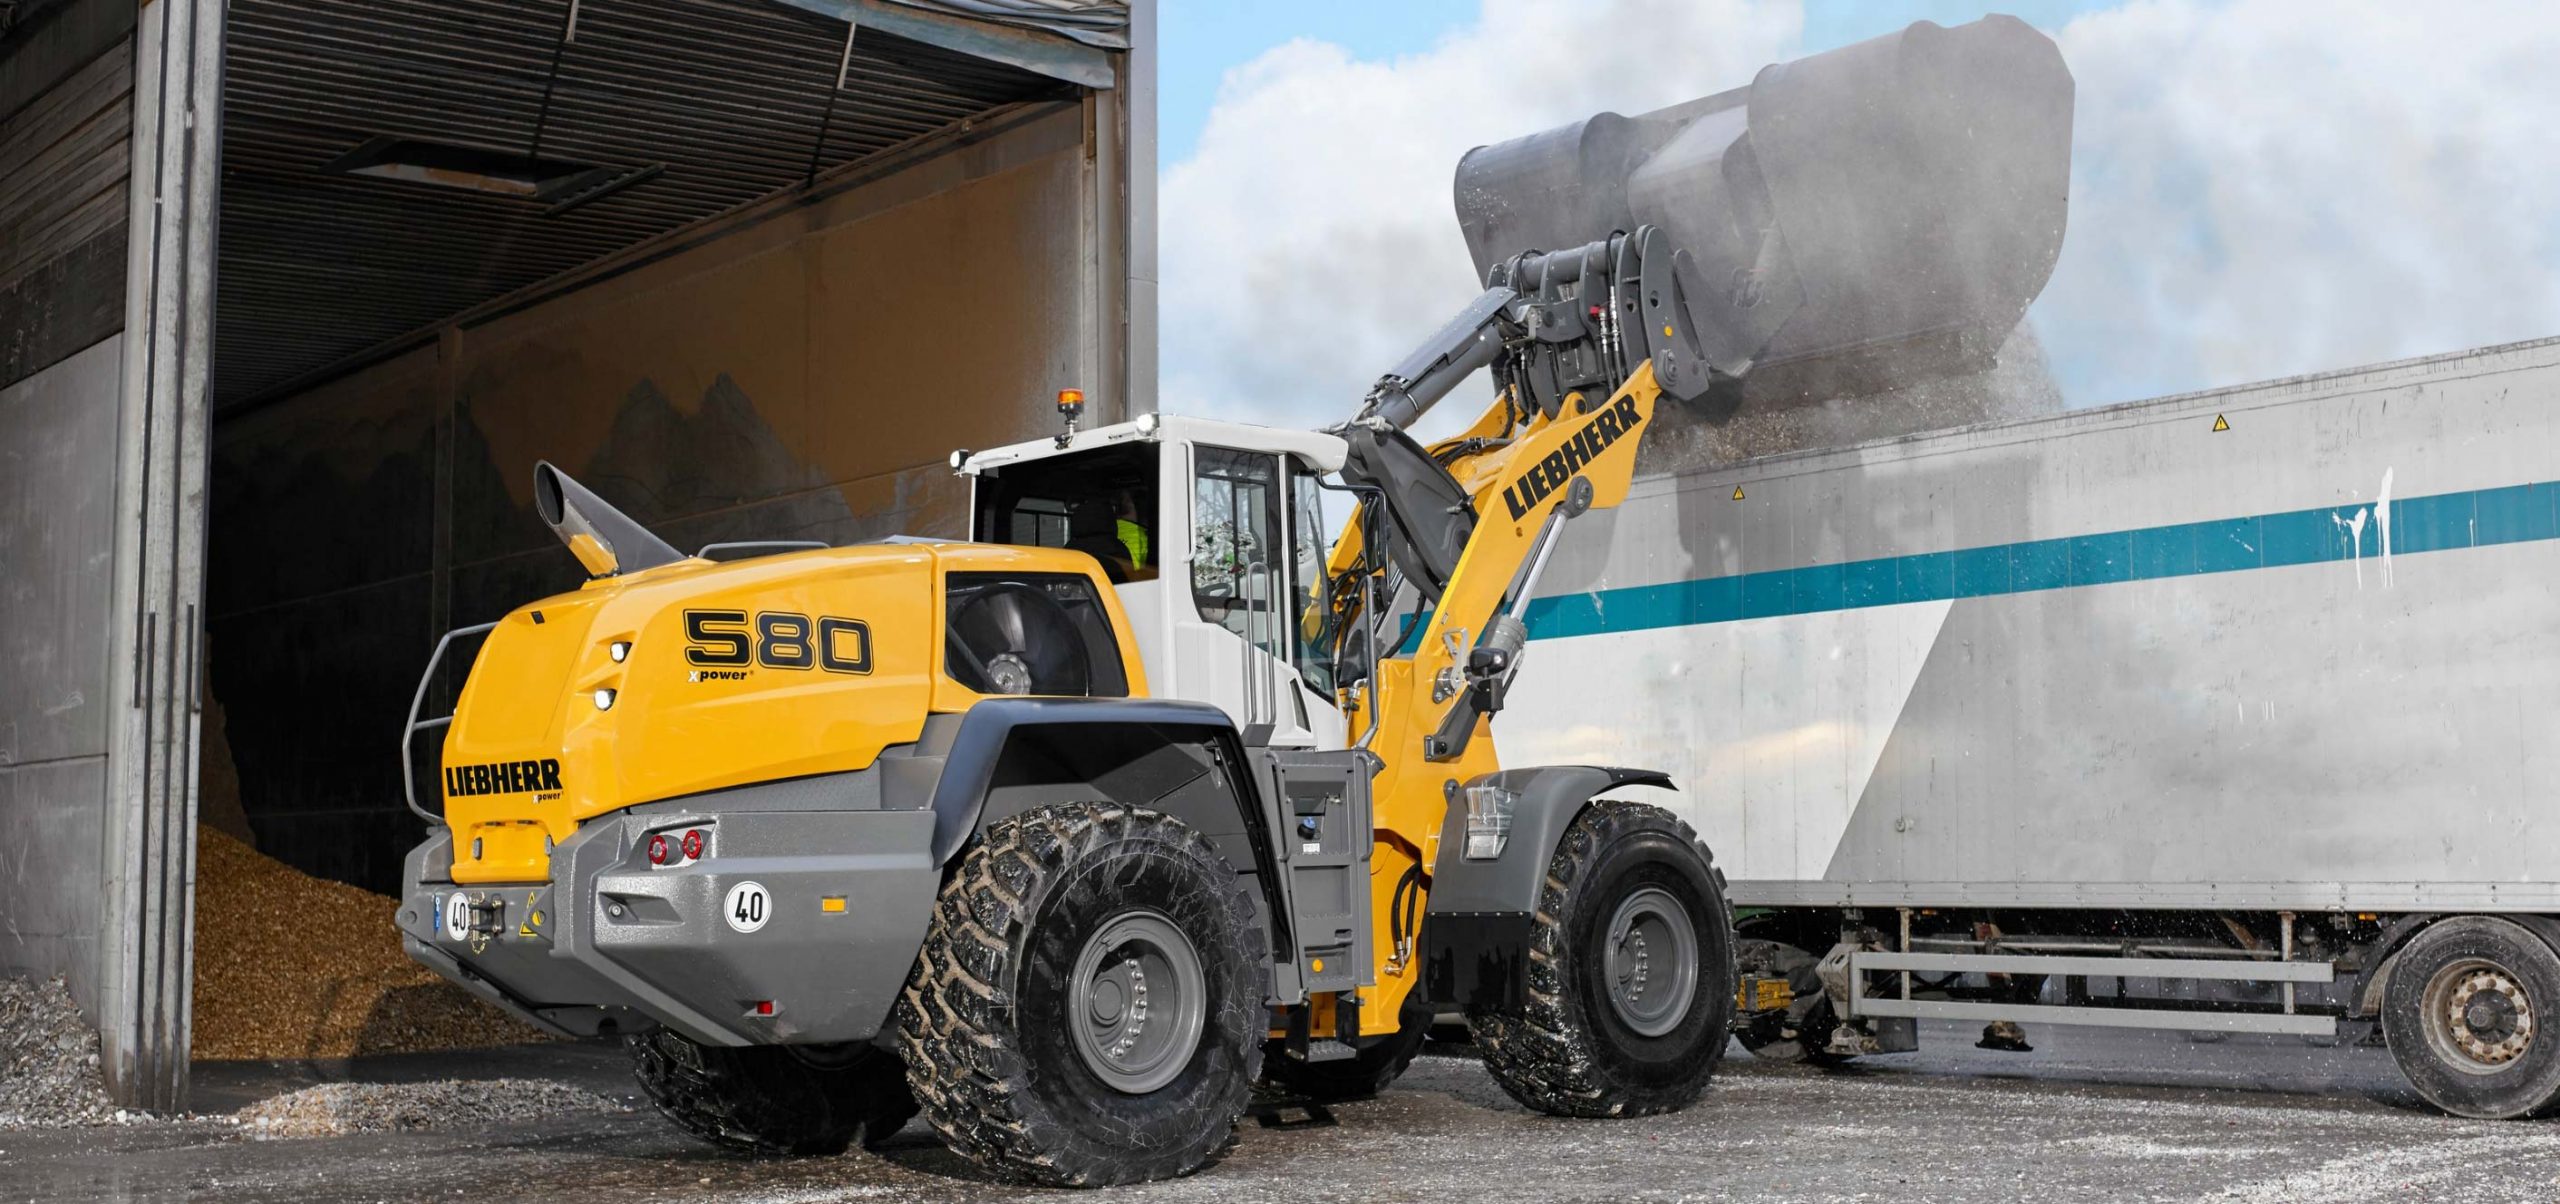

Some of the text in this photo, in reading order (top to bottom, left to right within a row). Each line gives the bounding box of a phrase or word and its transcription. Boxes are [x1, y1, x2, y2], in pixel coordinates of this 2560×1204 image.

[1502, 394, 1642, 522] LIEBHERR
[683, 609, 874, 676] 580
[445, 758, 563, 797] LIEBHERR
[452, 902, 466, 931] 40
[735, 891, 763, 923] 40
